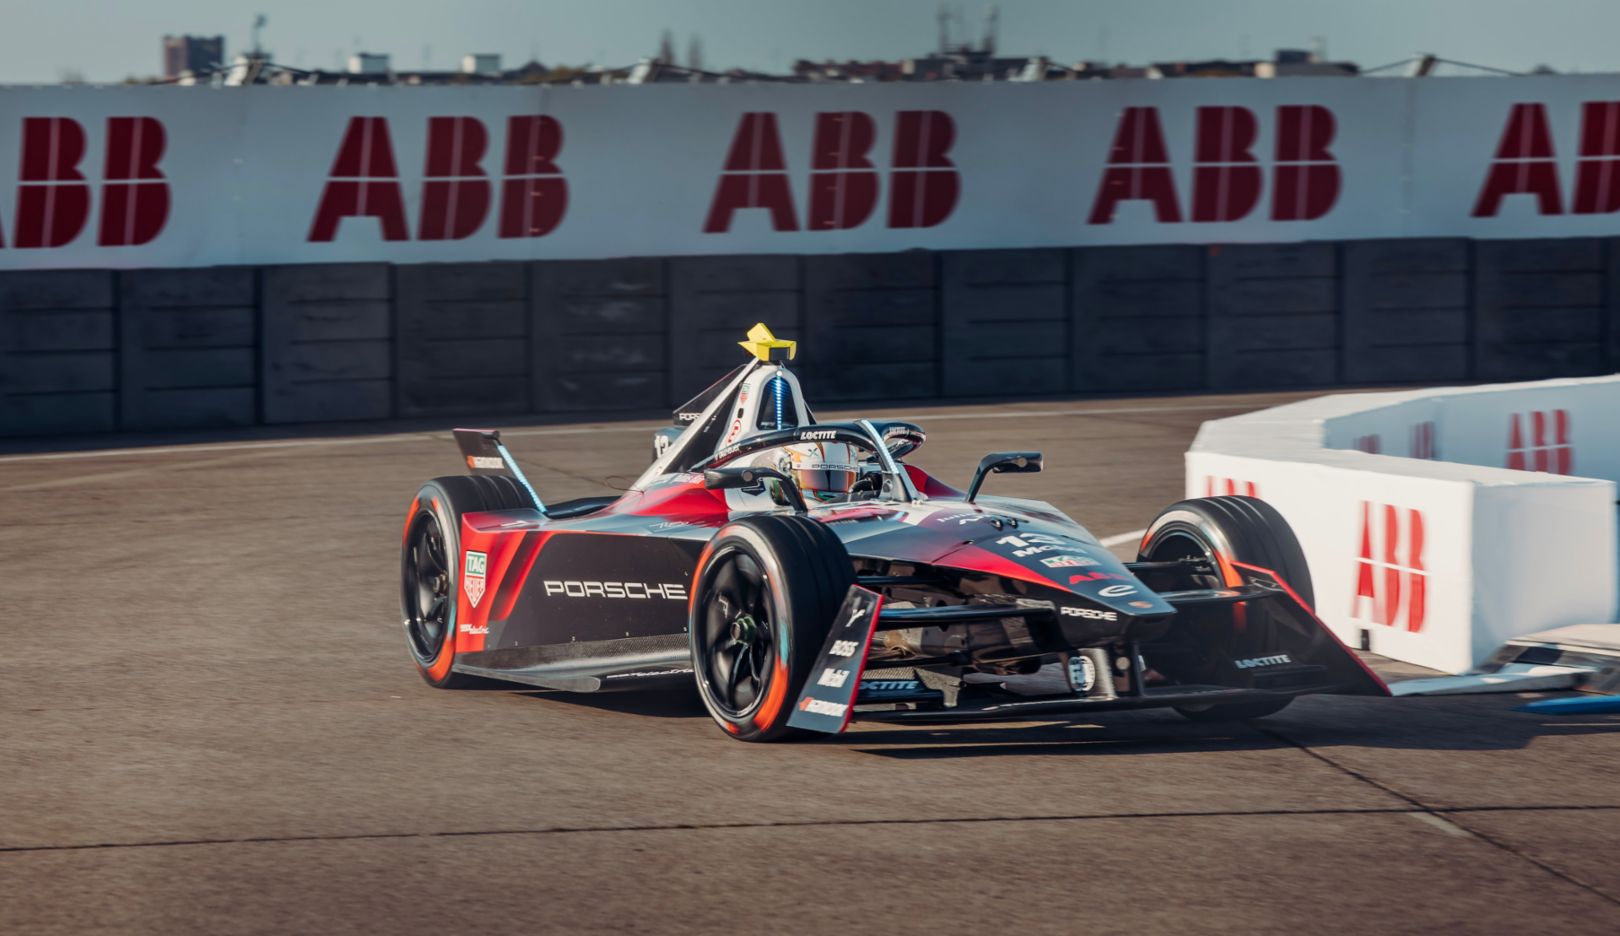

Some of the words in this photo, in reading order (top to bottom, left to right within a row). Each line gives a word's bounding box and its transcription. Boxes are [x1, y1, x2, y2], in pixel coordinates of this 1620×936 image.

[0, 117, 171, 248] BB
[307, 116, 570, 242] ABB
[702, 111, 961, 232] ABB
[1086, 105, 1343, 224] ABB
[800, 430, 837, 441] LOCTITE
[1506, 408, 1575, 476] ABB
[467, 556, 485, 573] TAG
[1350, 500, 1430, 634] ABB
[544, 580, 688, 600] PORSCHE
[1060, 606, 1118, 621] PORSCHE
[1234, 654, 1292, 669] LOCTITE
[859, 680, 919, 690] OCTITE
